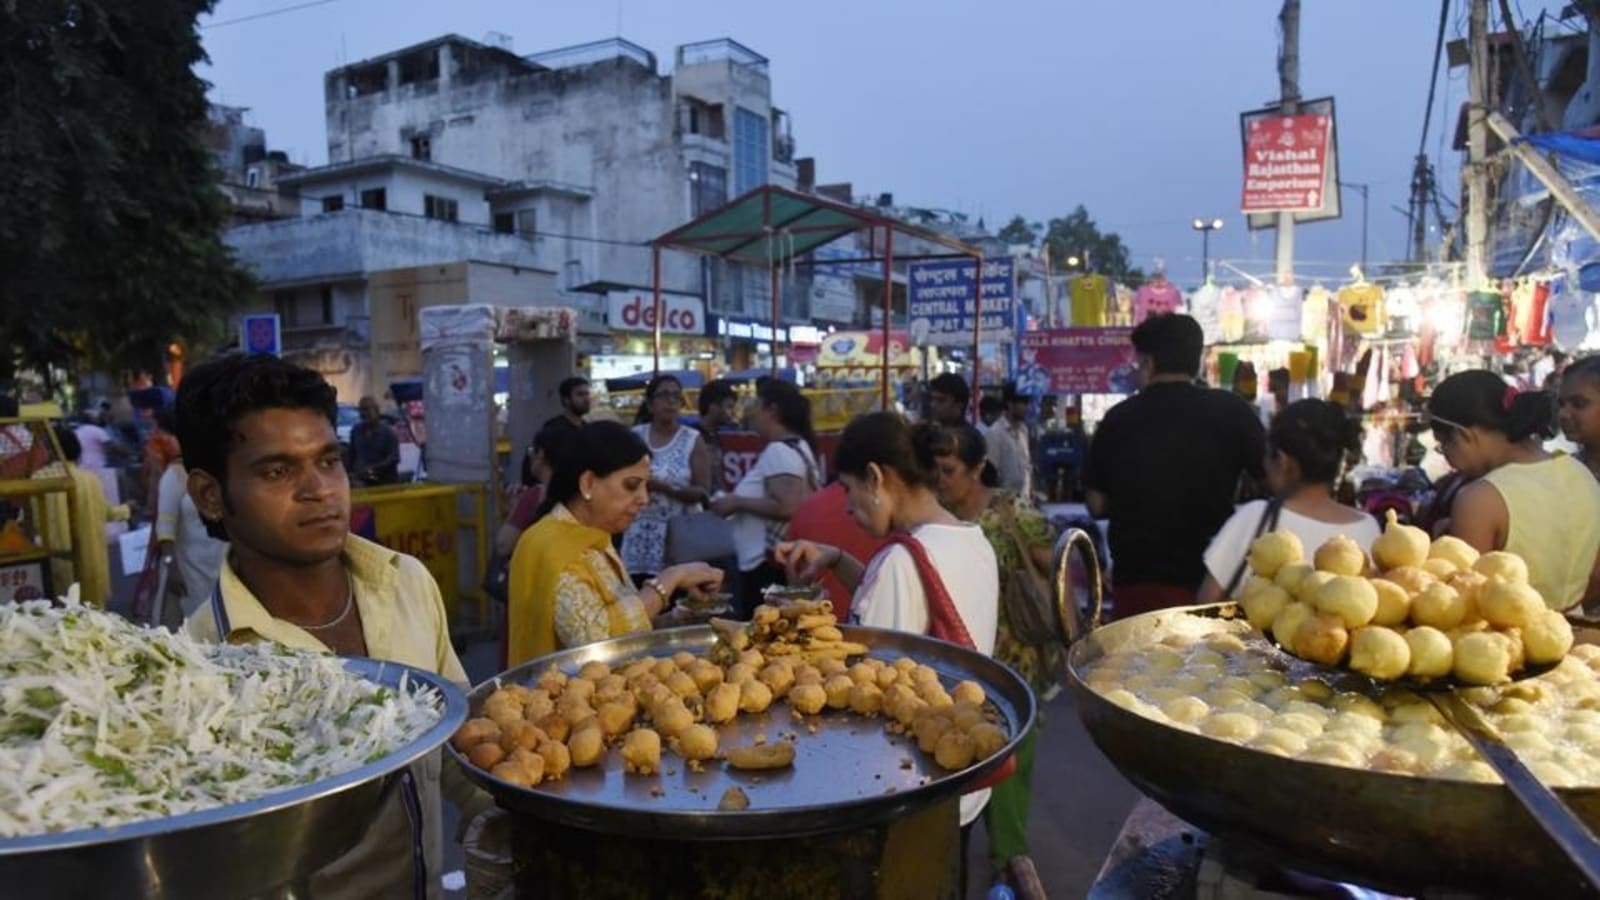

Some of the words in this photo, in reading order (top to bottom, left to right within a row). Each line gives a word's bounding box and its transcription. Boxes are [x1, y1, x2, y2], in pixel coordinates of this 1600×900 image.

[1256, 148, 1317, 161] Vishal
[621, 295, 695, 330] delco
[911, 301, 960, 316] CENTRAL
[964, 298, 1011, 314] MRKET
[963, 316, 1003, 329] NGAR
